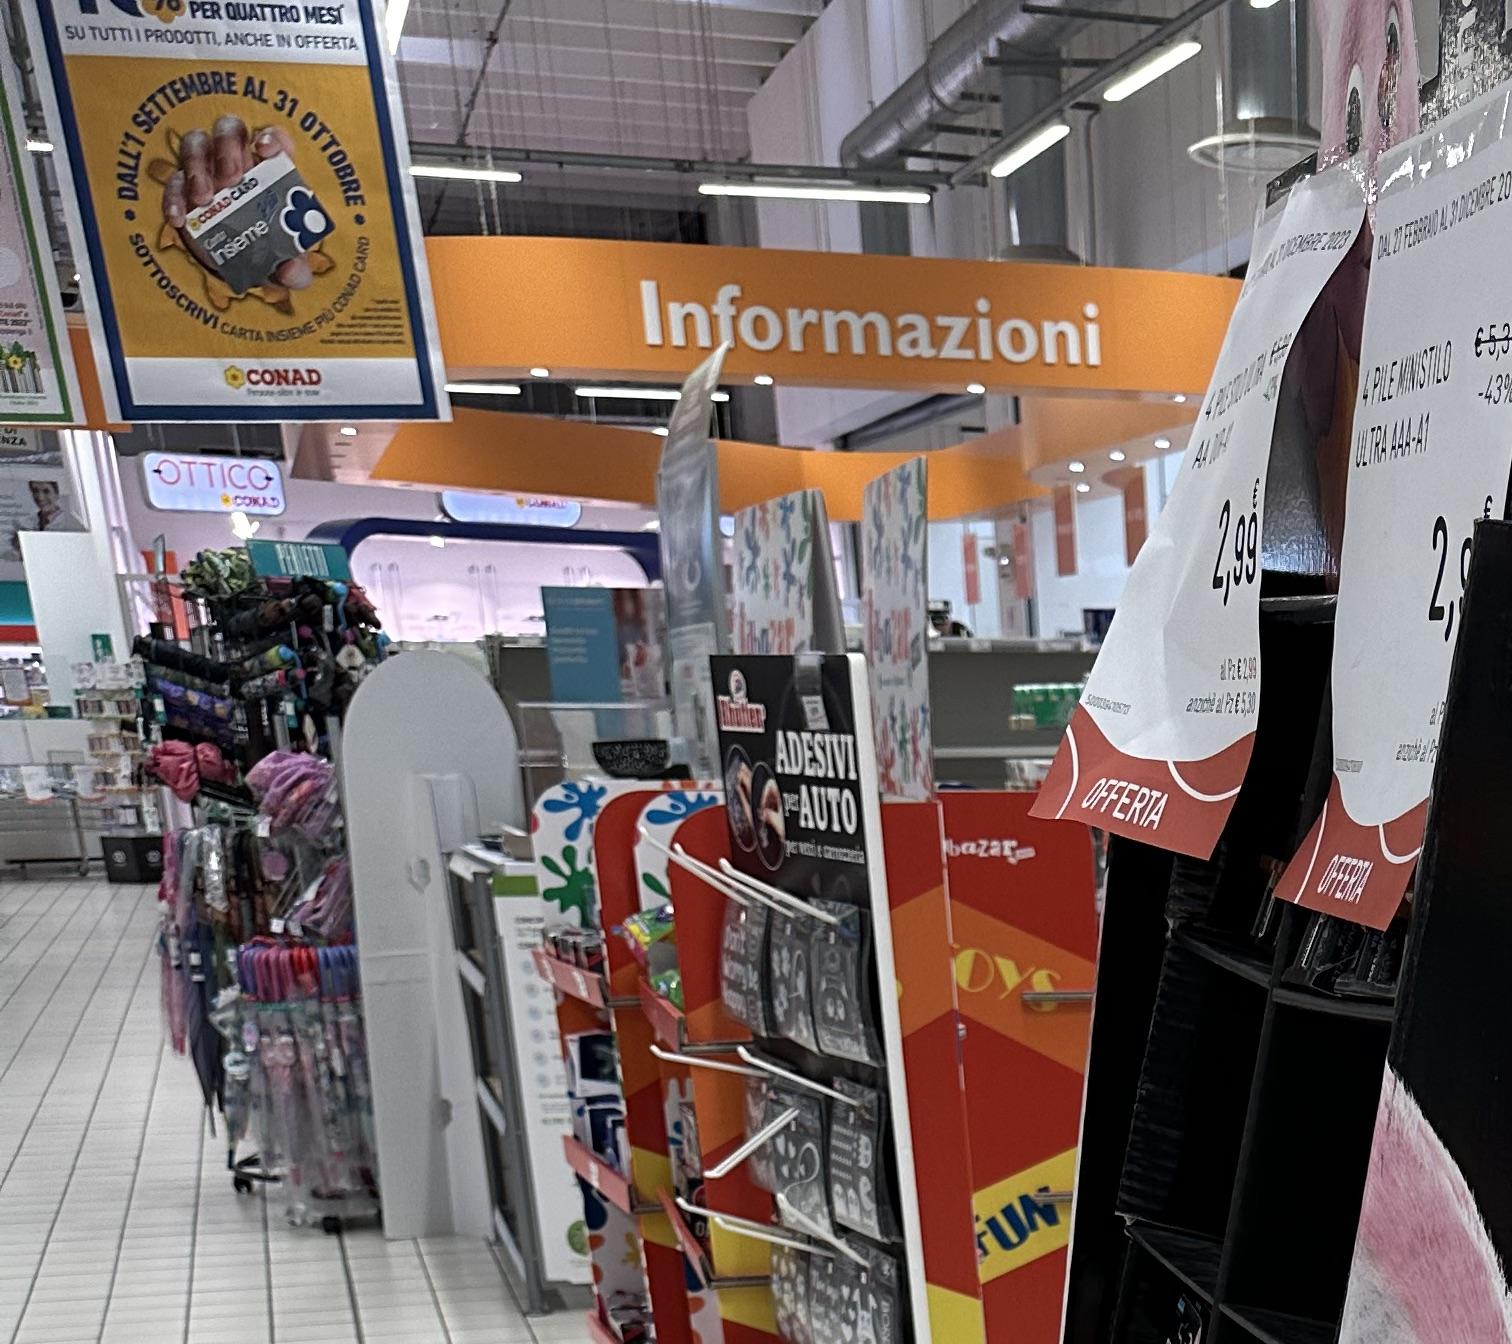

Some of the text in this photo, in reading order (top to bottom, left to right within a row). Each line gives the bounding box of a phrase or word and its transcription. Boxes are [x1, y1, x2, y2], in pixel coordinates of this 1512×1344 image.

[190, 1, 223, 20] PER
[226, 2, 300, 23] QUATTRO
[65, 25, 85, 40] SU
[89, 27, 133, 42] TUTTI
[225, 33, 272, 48] ANCHE
[276, 34, 292, 48] IN
[295, 35, 359, 51] OFFERTA
[131, 71, 238, 134] SETTEMBRE
[243, 76, 268, 103] AL
[273, 90, 299, 117] 31
[300, 111, 366, 207] OTTOBRE
[129, 232, 219, 330] SOTTOSCRIVI
[220, 322, 265, 343] CARTA
[266, 321, 317, 343] INSIEME
[333, 273, 362, 314] CONAD
[640, 280, 1102, 367] Informazioni
[247, 369, 322, 386] CONAD
[1371, 360, 1398, 403] PILE
[1399, 340, 1453, 399] MINISTILO
[1355, 424, 1387, 468] ULTRA
[157, 459, 273, 491] OTTICO
[1211, 499, 1259, 607] 2,99
[775, 730, 858, 781] ADESIVI
[799, 784, 858, 835] AUTO
[1081, 777, 1170, 831] OFFERTA
[1317, 854, 1374, 905] OFFERTA
[975, 1186, 1062, 1260] FUN
